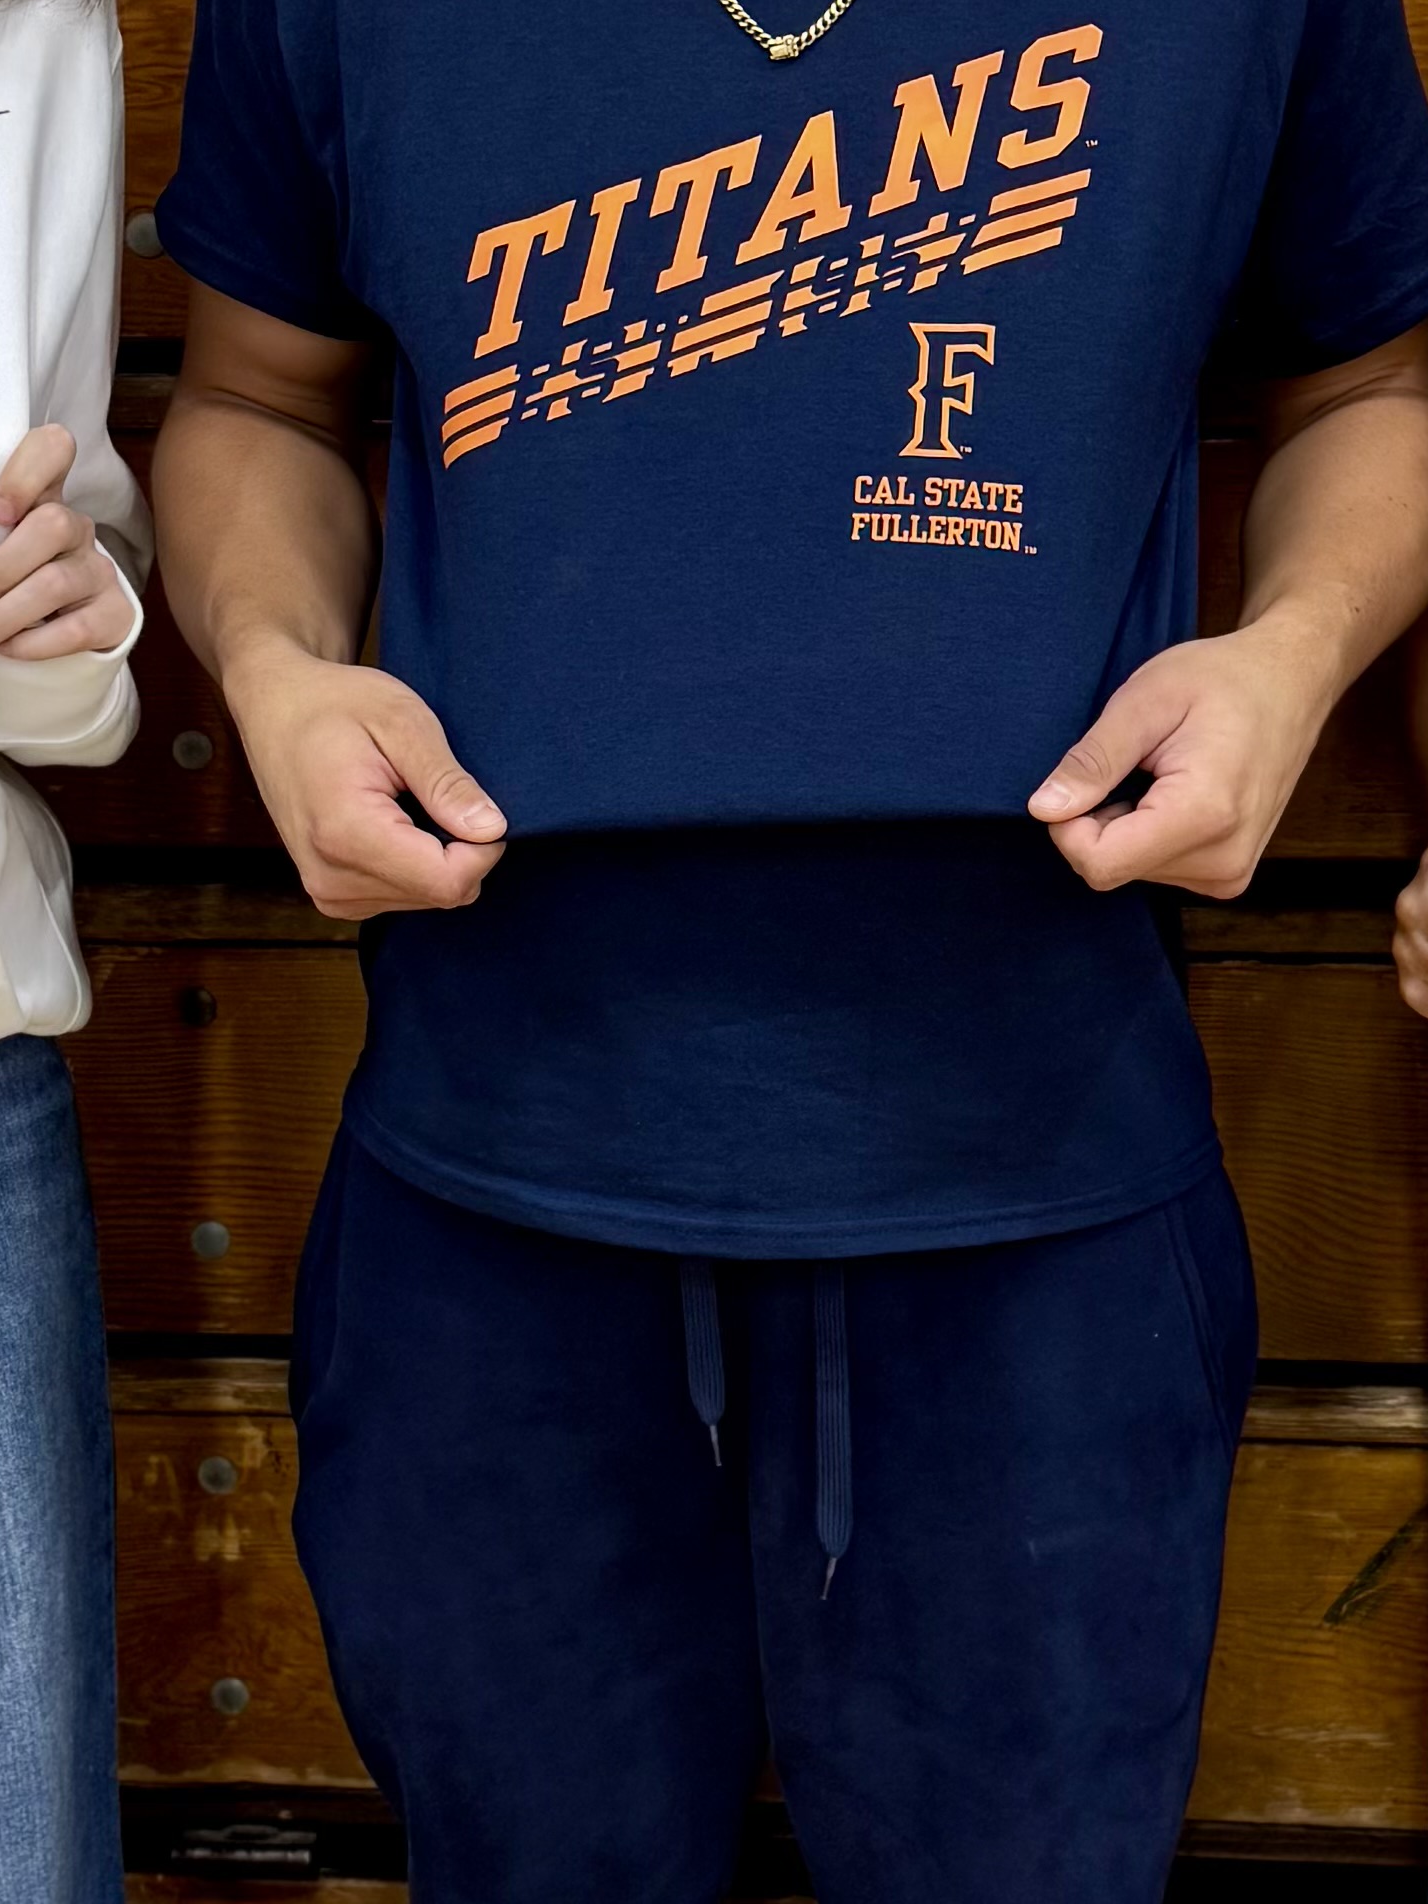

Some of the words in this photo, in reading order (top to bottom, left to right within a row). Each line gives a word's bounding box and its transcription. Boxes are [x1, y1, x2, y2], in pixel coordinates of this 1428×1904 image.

[467, 23, 1103, 359] TITANS
[899, 322, 996, 460] F
[851, 512, 1023, 552] FULLERTON
[854, 475, 915, 506] CAL
[924, 477, 1024, 514] STATE
